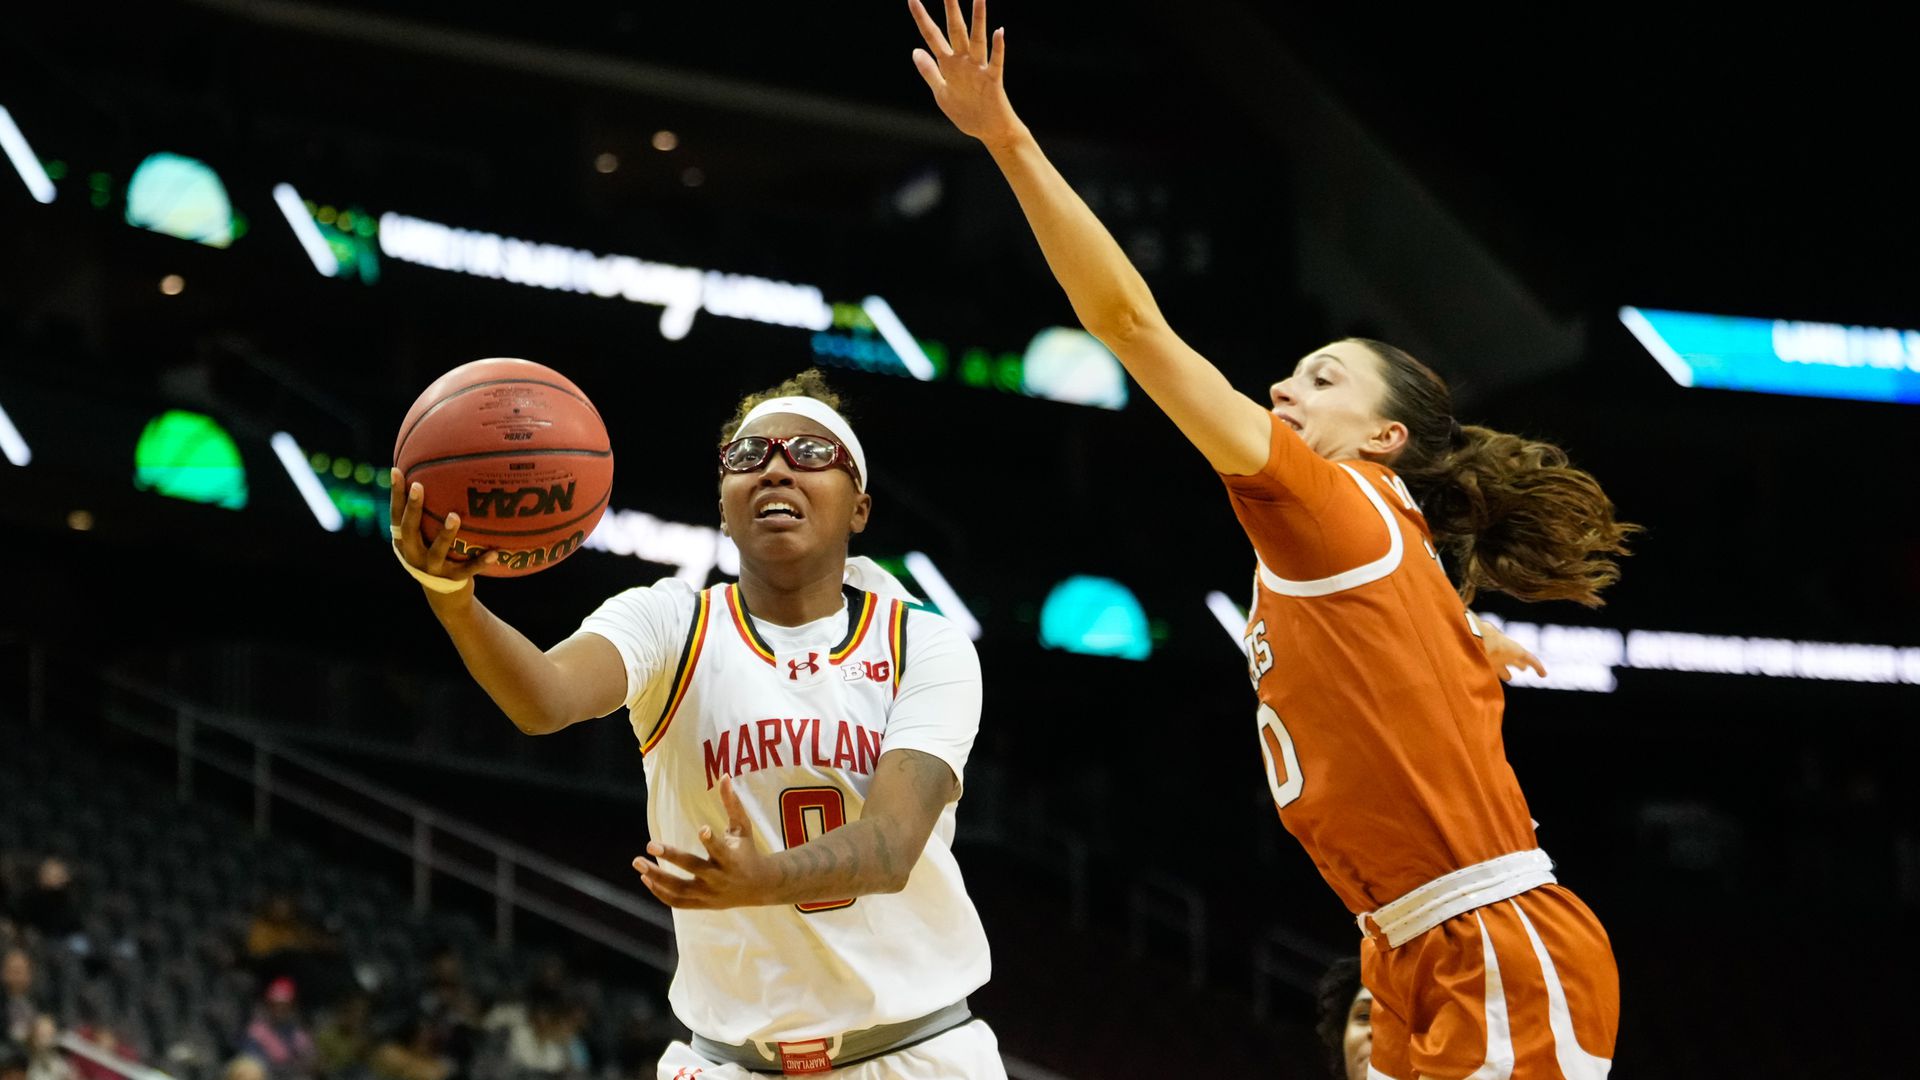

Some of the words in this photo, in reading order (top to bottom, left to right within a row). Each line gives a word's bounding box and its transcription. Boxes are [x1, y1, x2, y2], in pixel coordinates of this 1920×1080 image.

[467, 481, 577, 519] NCAA
[703, 718, 884, 790] MARYLAN
[778, 785, 857, 914] 0
[786, 1057, 826, 1070] MARYLAND
